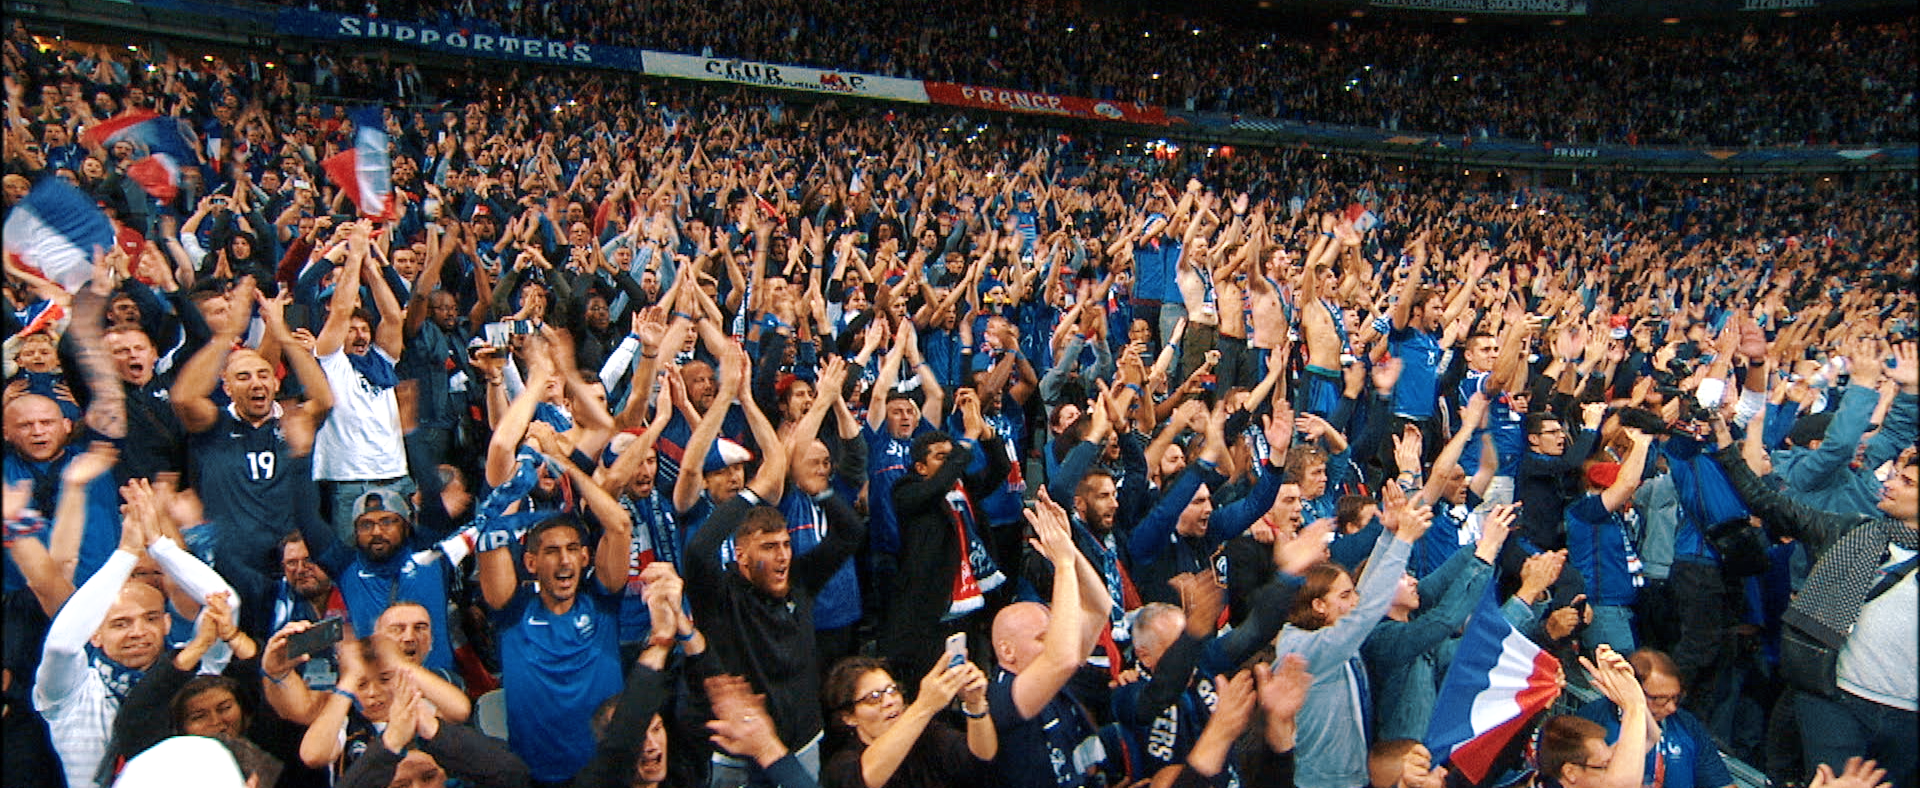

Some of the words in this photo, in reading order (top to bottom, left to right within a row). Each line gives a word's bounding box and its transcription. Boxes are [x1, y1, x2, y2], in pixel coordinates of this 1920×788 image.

[338, 17, 593, 62] SUPPORTERS
[961, 86, 1065, 110] FRANCE
[1553, 147, 1599, 158] FRANCE
[246, 451, 275, 480] 19
